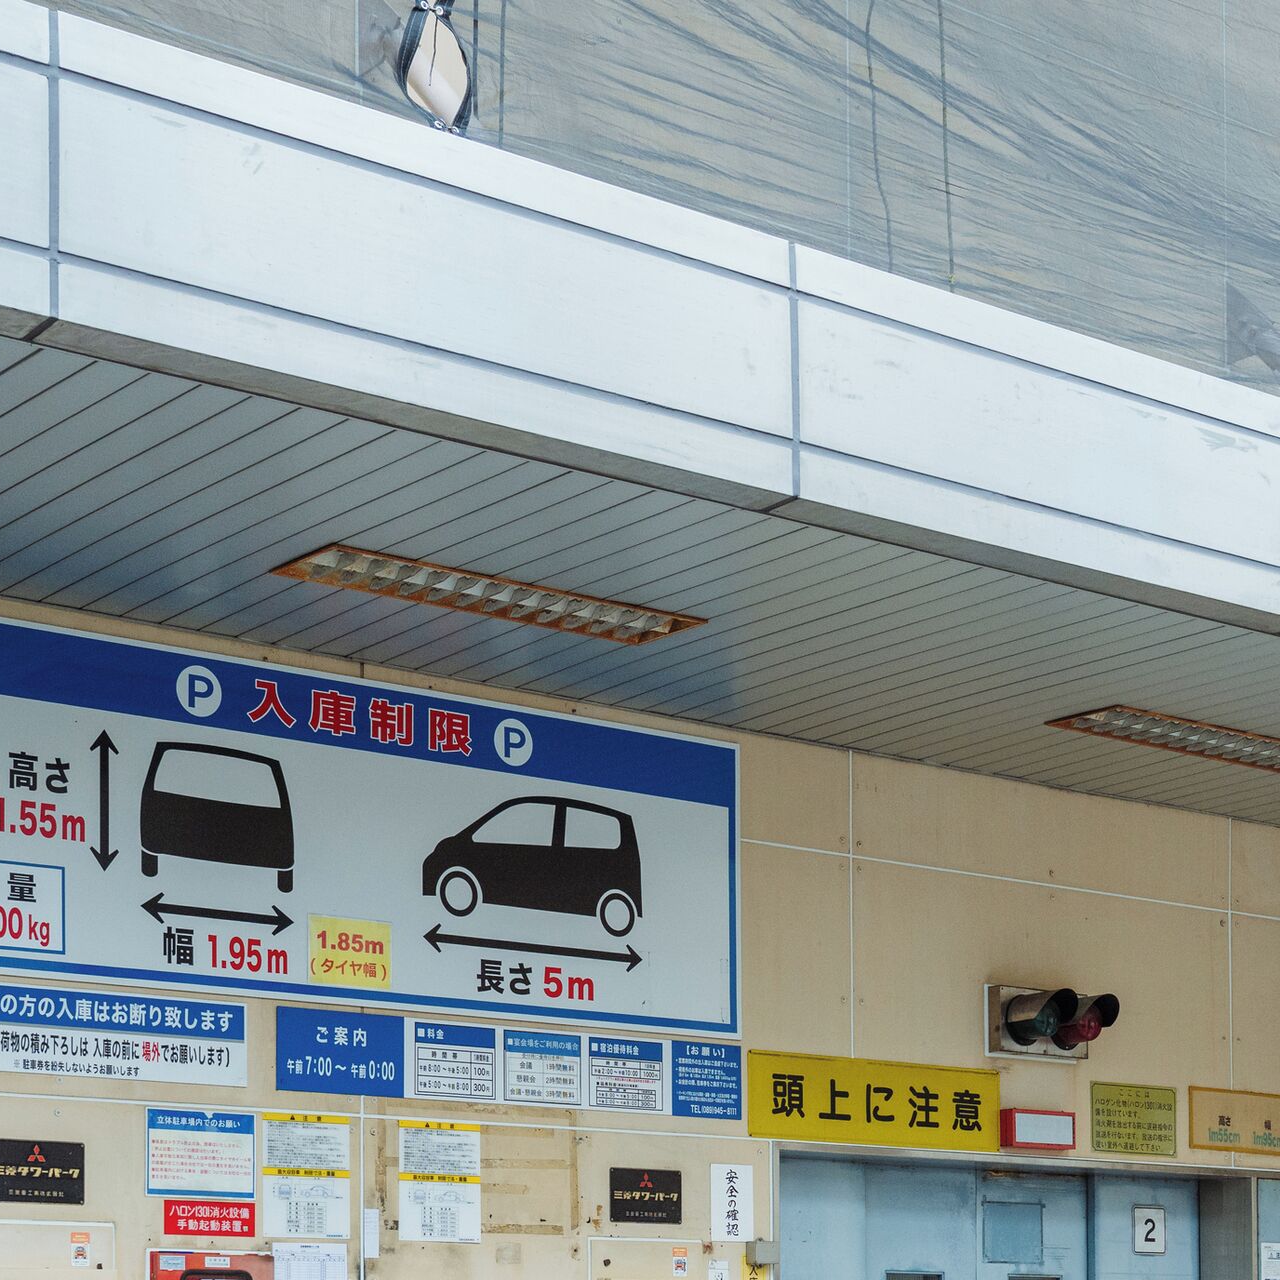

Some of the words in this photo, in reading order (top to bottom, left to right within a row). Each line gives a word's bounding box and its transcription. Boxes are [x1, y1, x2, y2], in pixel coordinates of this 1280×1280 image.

[248, 679, 472, 757] 入庫制限
[8, 751, 71, 794] 高さ
[163, 926, 194, 966] 幅
[316, 930, 384, 955] 1.85m
[476, 959, 533, 995] 長さ
[316, 1026, 367, 1047] ご案内
[519, 1061, 533, 1070] 会議
[473, 1083, 491, 1093] 300円
[771, 1073, 982, 1131] 頭上に注意
[1218, 1115, 1231, 1127] 高さ
[169, 1204, 250, 1220] ハロン1301消火設備
[724, 1169, 739, 1237] 安全の確認
[177, 1219, 242, 1233] 手動起動装置
[1144, 1218, 1156, 1243] 2
